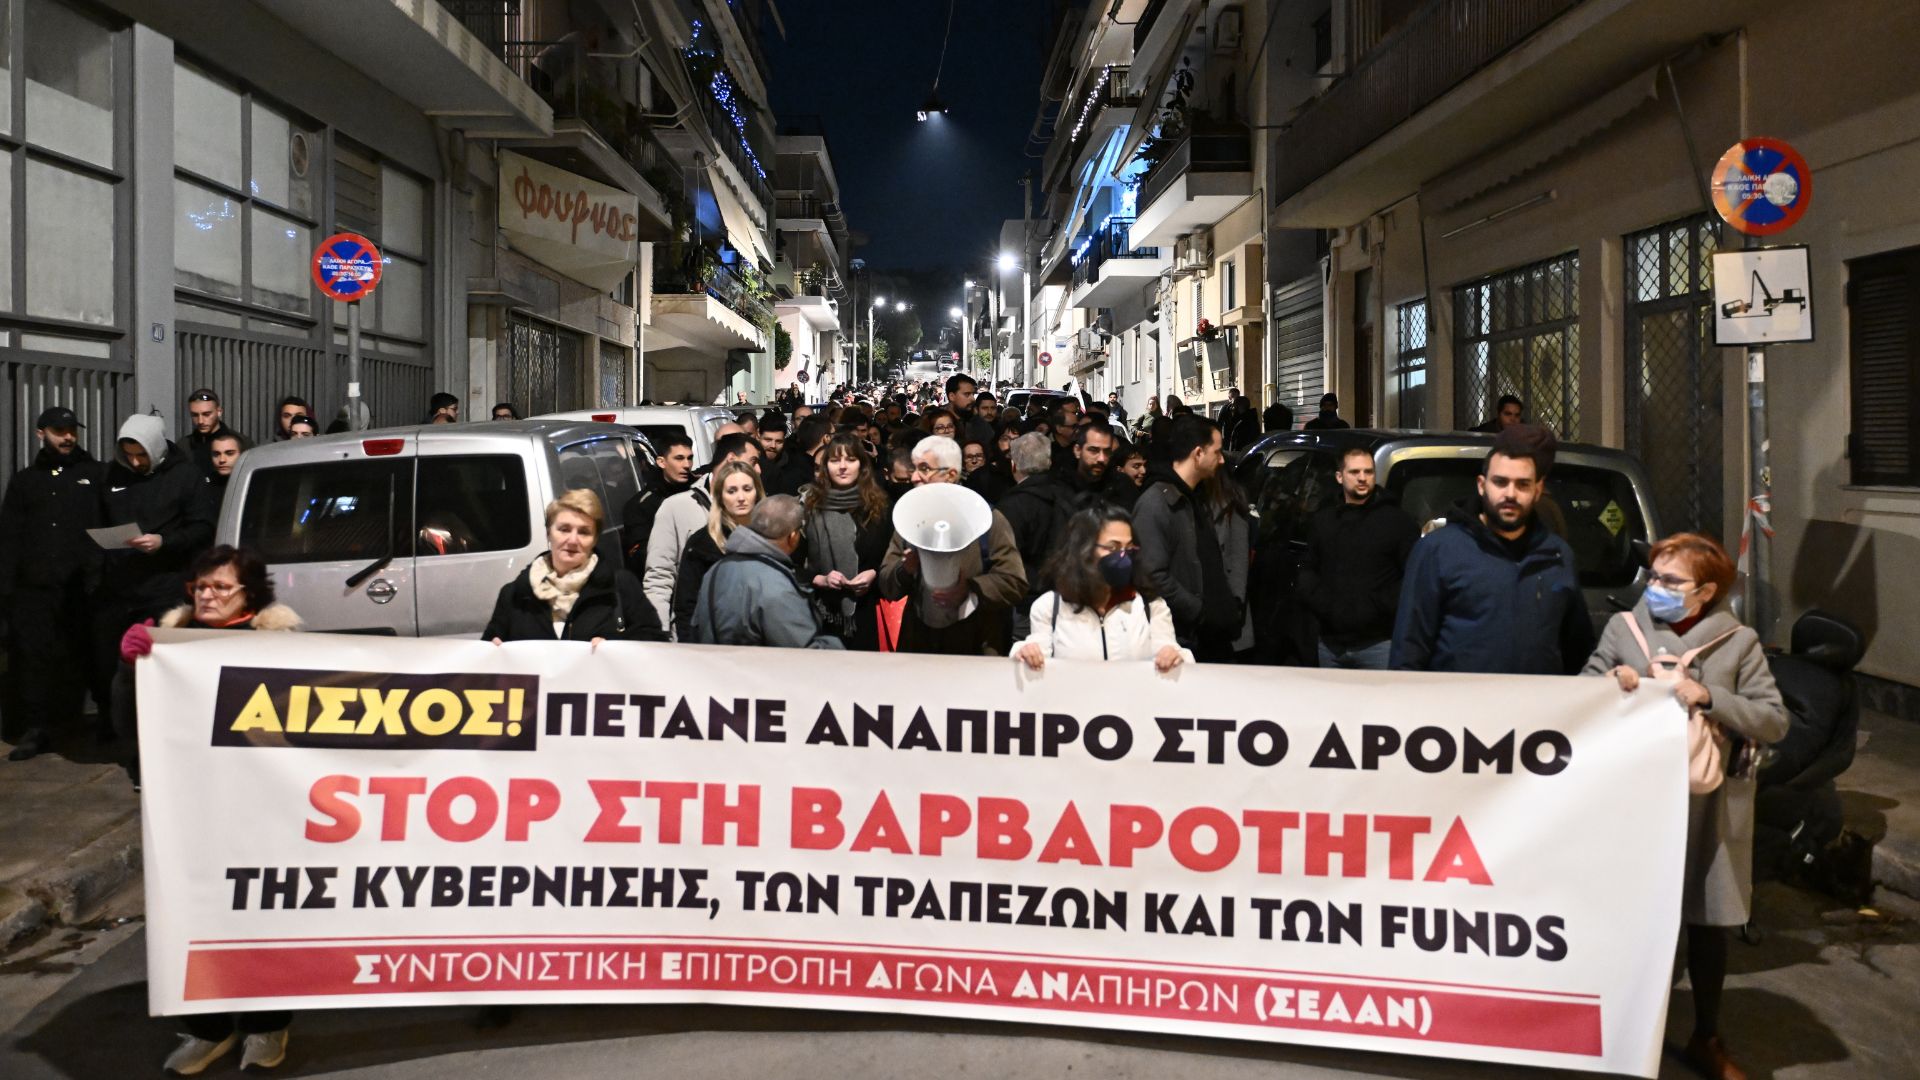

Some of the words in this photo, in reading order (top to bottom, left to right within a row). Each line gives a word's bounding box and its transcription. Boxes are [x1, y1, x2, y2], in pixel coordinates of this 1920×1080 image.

[230, 682, 525, 737] ΑΙΣΧΟΣ!
[545, 692, 787, 743] ΠΕΤΑΝΕ
[805, 701, 1134, 761] ΑΝΑΠΗΡΟ
[1153, 717, 1289, 767] ΣΤΟ
[1309, 721, 1573, 776] ΔΡΟΜΟ
[304, 774, 561, 844] STOP
[583, 779, 761, 847] ΣΤΗ
[790, 786, 1494, 886] ΒΑΡΒΑΡΟΤΗΤΑ
[225, 866, 338, 911] ΤΗΣ
[352, 865, 720, 920] ΚΥΒΕΡΝΗΣΗΣ,
[735, 870, 840, 916] ΤΩΝ
[854, 875, 1128, 932] ΤΡΑΠΕΖΩΝ
[1145, 892, 1236, 938] ΚΑΙ
[1250, 897, 1363, 947] ΤΩΝ
[1380, 904, 1569, 962] FUNDS
[352, 951, 647, 984] ΣΥΝΤΟΝΙΣΤΙΚΗ
[660, 952, 852, 987] ΕΠΙΤΡΟΠΗ
[865, 960, 999, 996] ΑΓΩΝΑ
[1011, 968, 1239, 1013] ΑΝΑΠΗΡΩΝ
[1254, 983, 1433, 1036] (ΣΕΑΑΝ)
